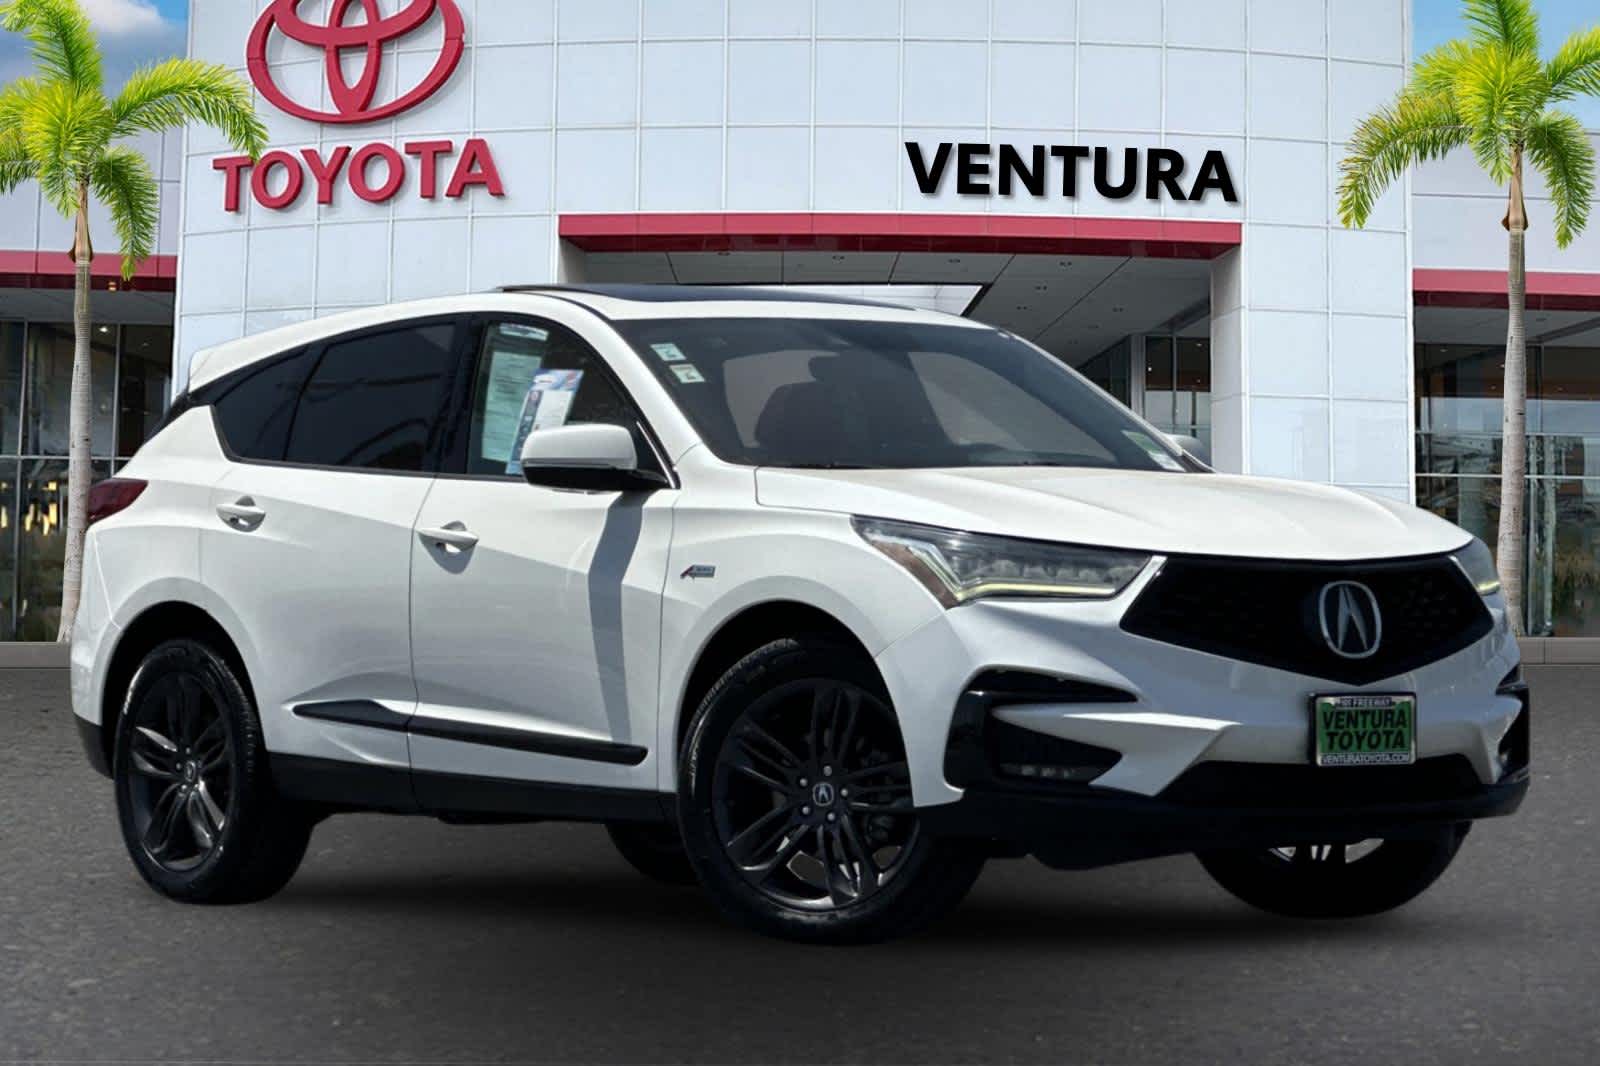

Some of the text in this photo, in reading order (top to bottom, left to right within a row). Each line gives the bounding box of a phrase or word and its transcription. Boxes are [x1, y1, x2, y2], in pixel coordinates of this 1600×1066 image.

[213, 139, 504, 211] TOYOTA
[905, 142, 1238, 202] VENTURA
[1322, 709, 1407, 729] VENTURA
[1326, 730, 1406, 750] TOYOTA
